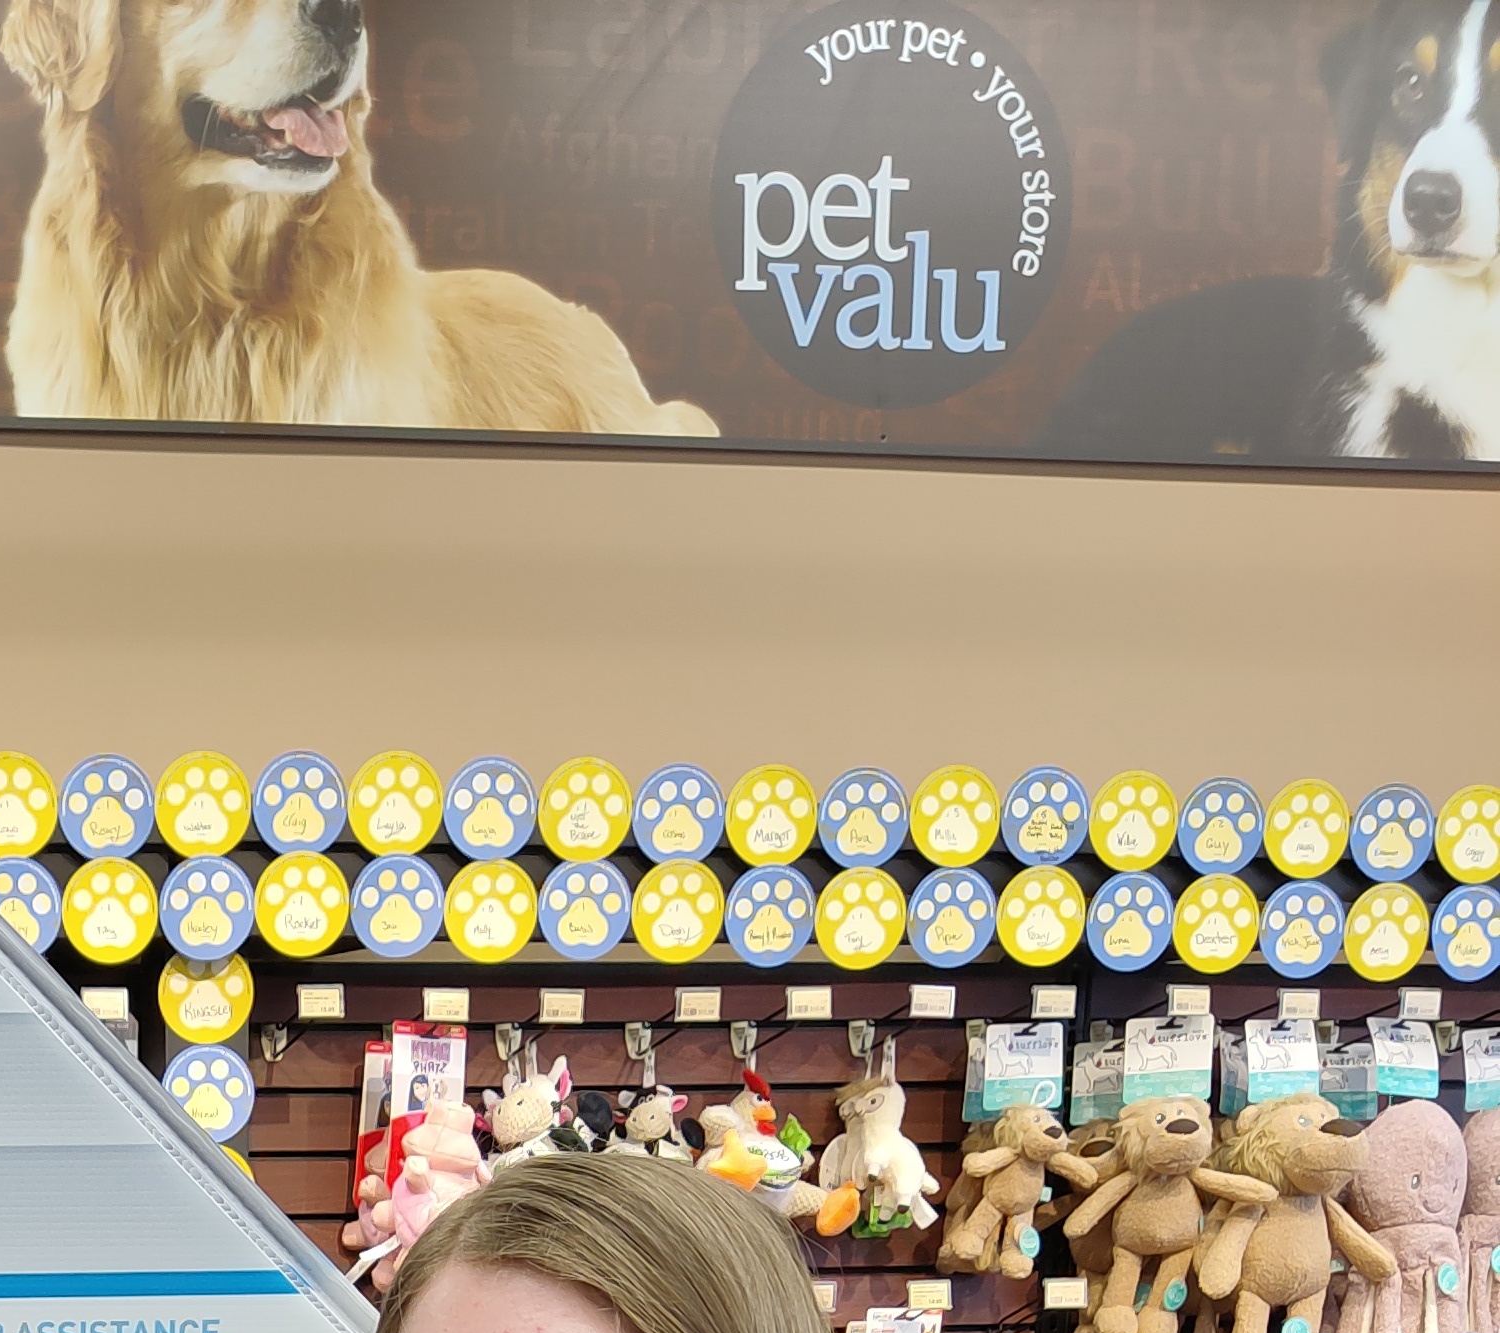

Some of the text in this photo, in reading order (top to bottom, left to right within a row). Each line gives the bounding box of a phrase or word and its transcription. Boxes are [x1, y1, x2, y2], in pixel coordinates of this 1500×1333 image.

[803, 17, 1053, 278] your pet your store
[733, 154, 911, 292] pet
[766, 230, 1007, 354] valu
